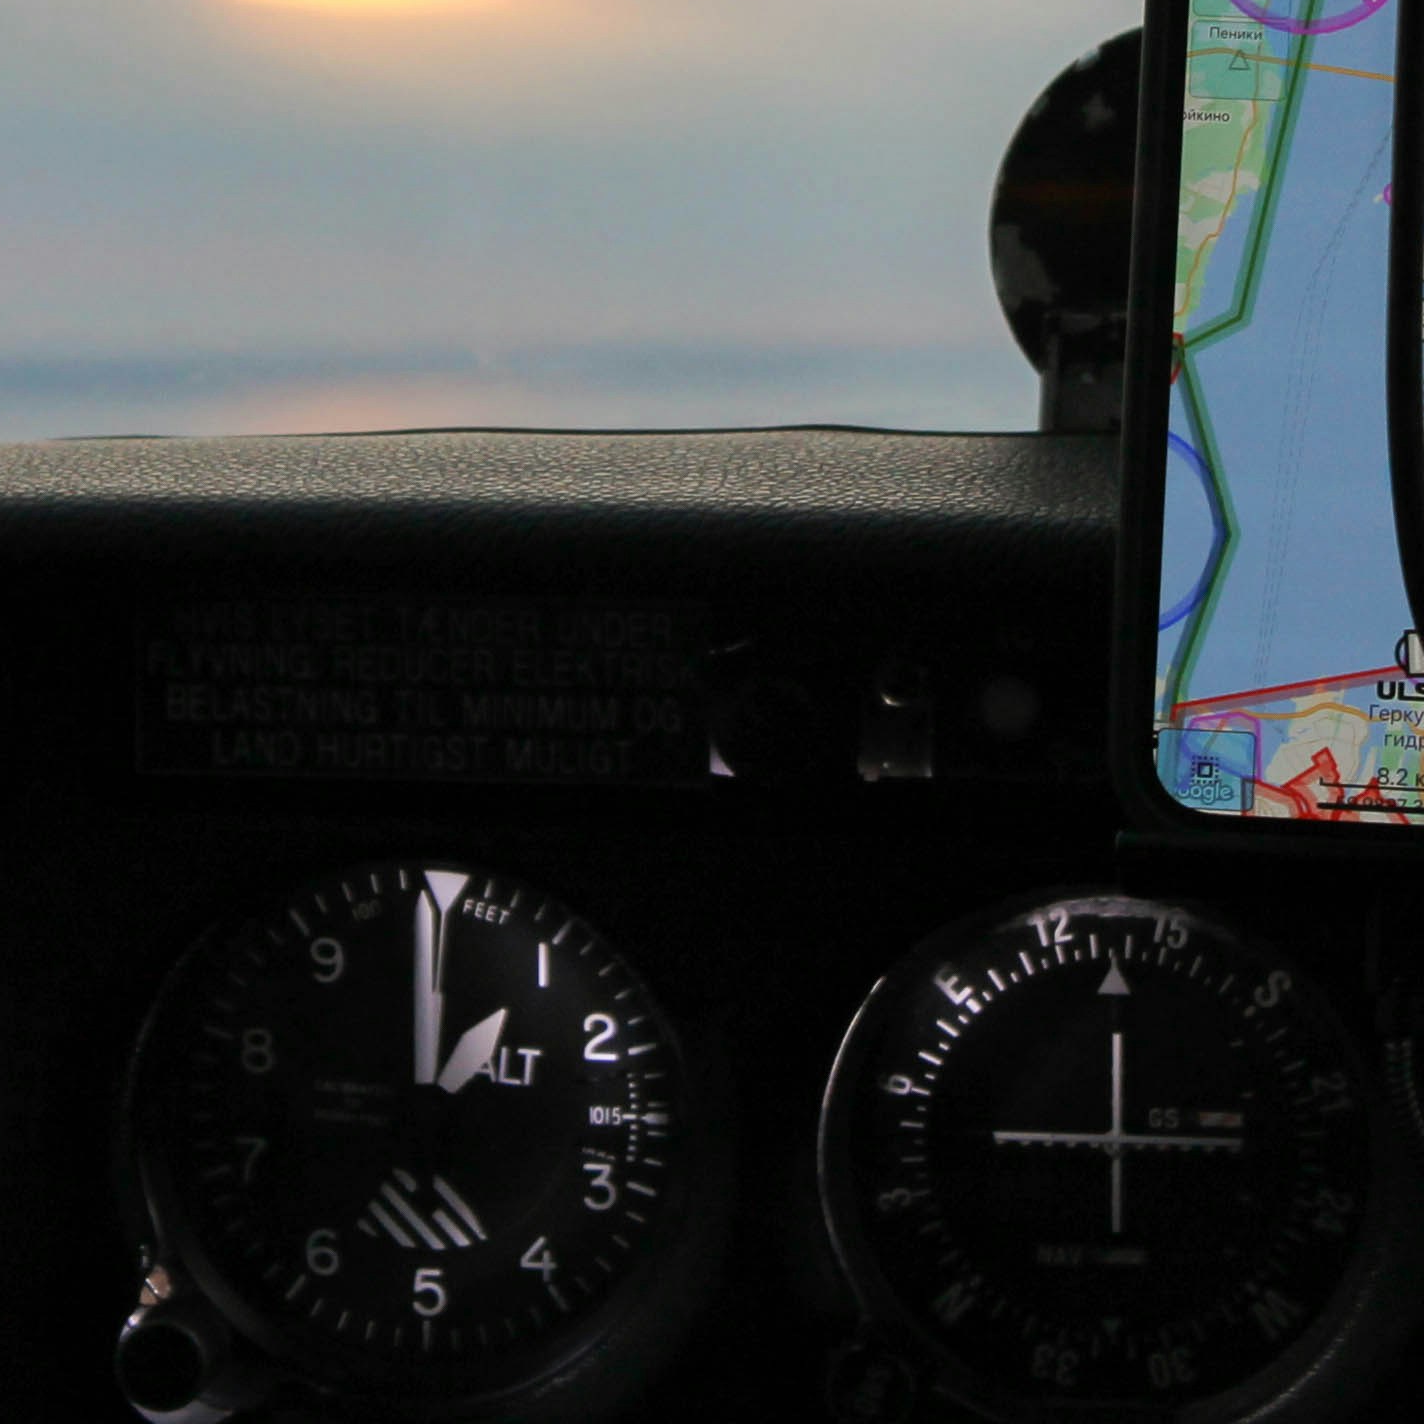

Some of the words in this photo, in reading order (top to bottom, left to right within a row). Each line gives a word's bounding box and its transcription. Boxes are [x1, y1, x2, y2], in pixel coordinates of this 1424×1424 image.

[1209, 26, 1263, 41] Пеники
[1377, 767, 1408, 786] 8.2
[462, 898, 511, 926] FEET
[1028, 907, 1074, 947] 12
[309, 936, 345, 984] 9
[1254, 969, 1292, 1008] S
[240, 1026, 274, 1074] 8
[583, 1012, 619, 1062] 2
[588, 1105, 622, 1126] 1015
[235, 1135, 269, 1185] 7
[582, 1161, 618, 1211] 3
[305, 1228, 340, 1276] 6
[519, 1235, 557, 1284] 4
[412, 1267, 448, 1317] 5
